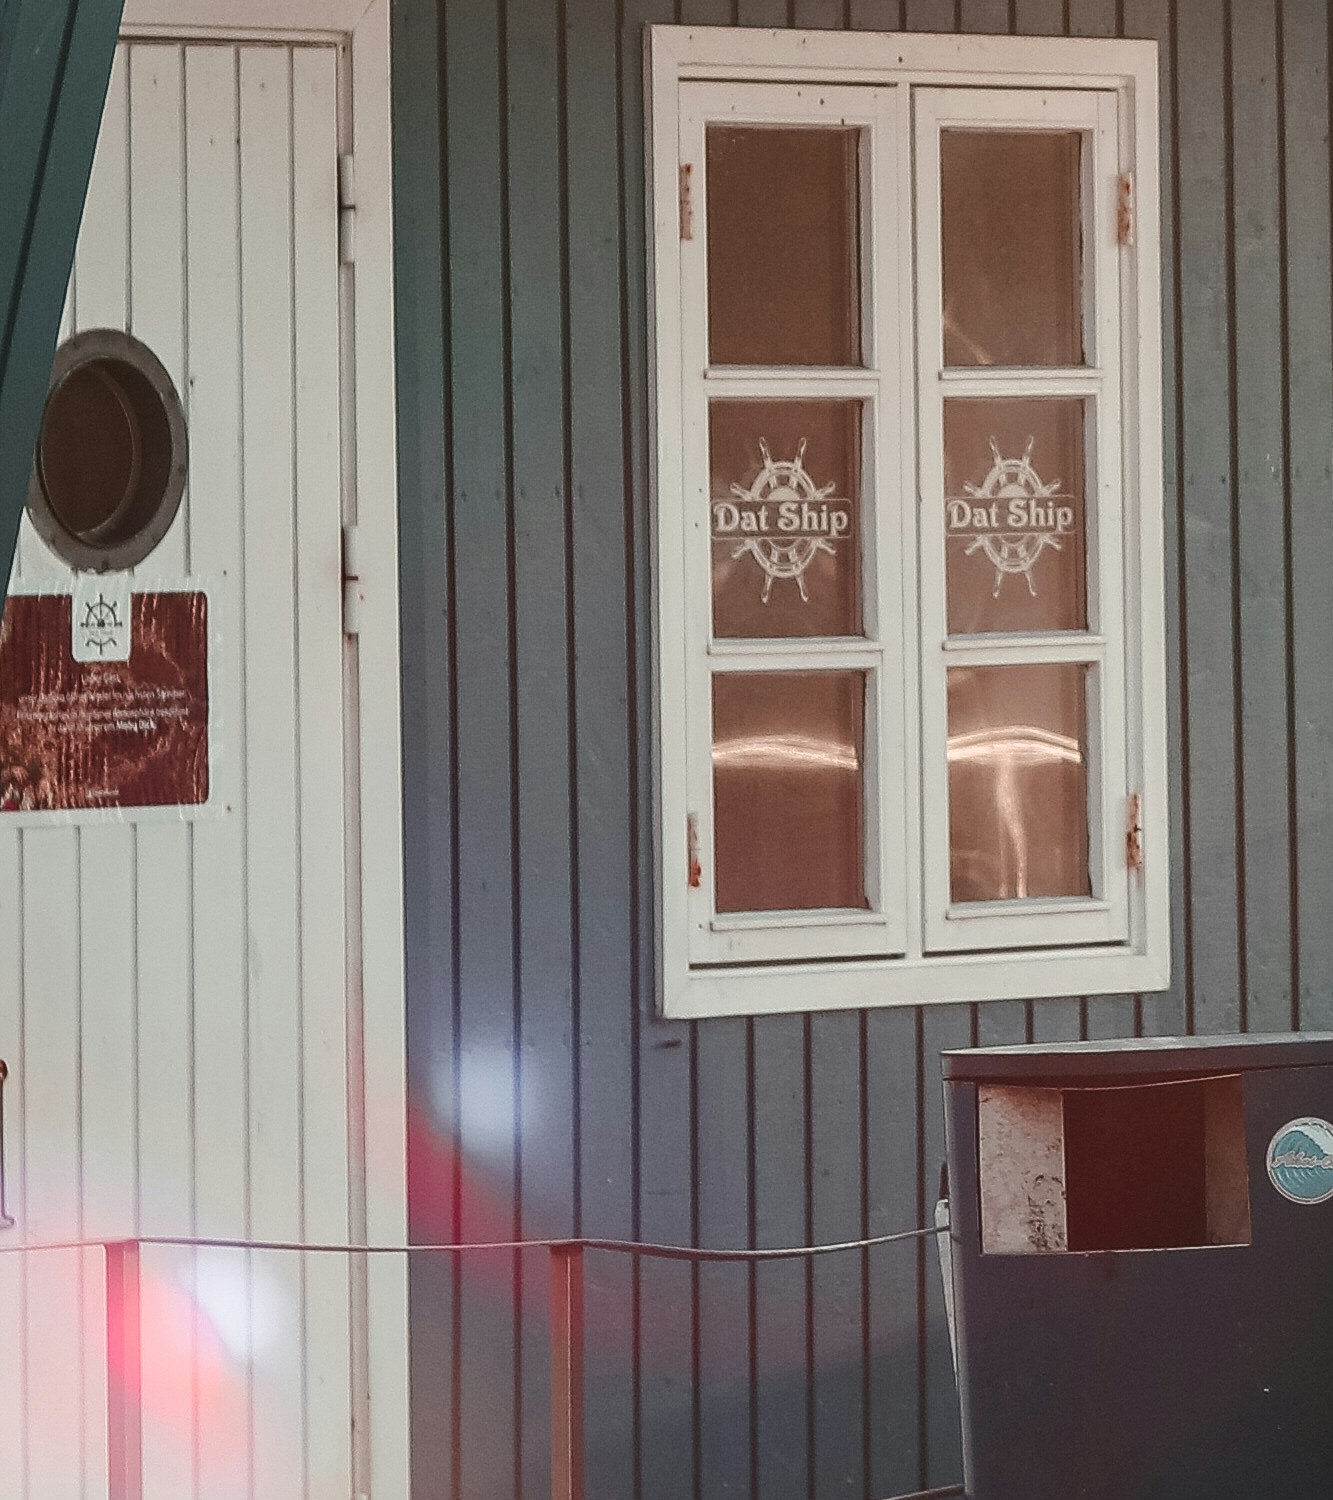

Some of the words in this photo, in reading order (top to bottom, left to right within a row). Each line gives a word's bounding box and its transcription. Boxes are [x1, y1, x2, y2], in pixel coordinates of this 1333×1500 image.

[713, 501, 770, 533] Dat
[776, 501, 849, 537] Ship
[949, 499, 1002, 529] Dat
[1006, 498, 1073, 532] Ship
